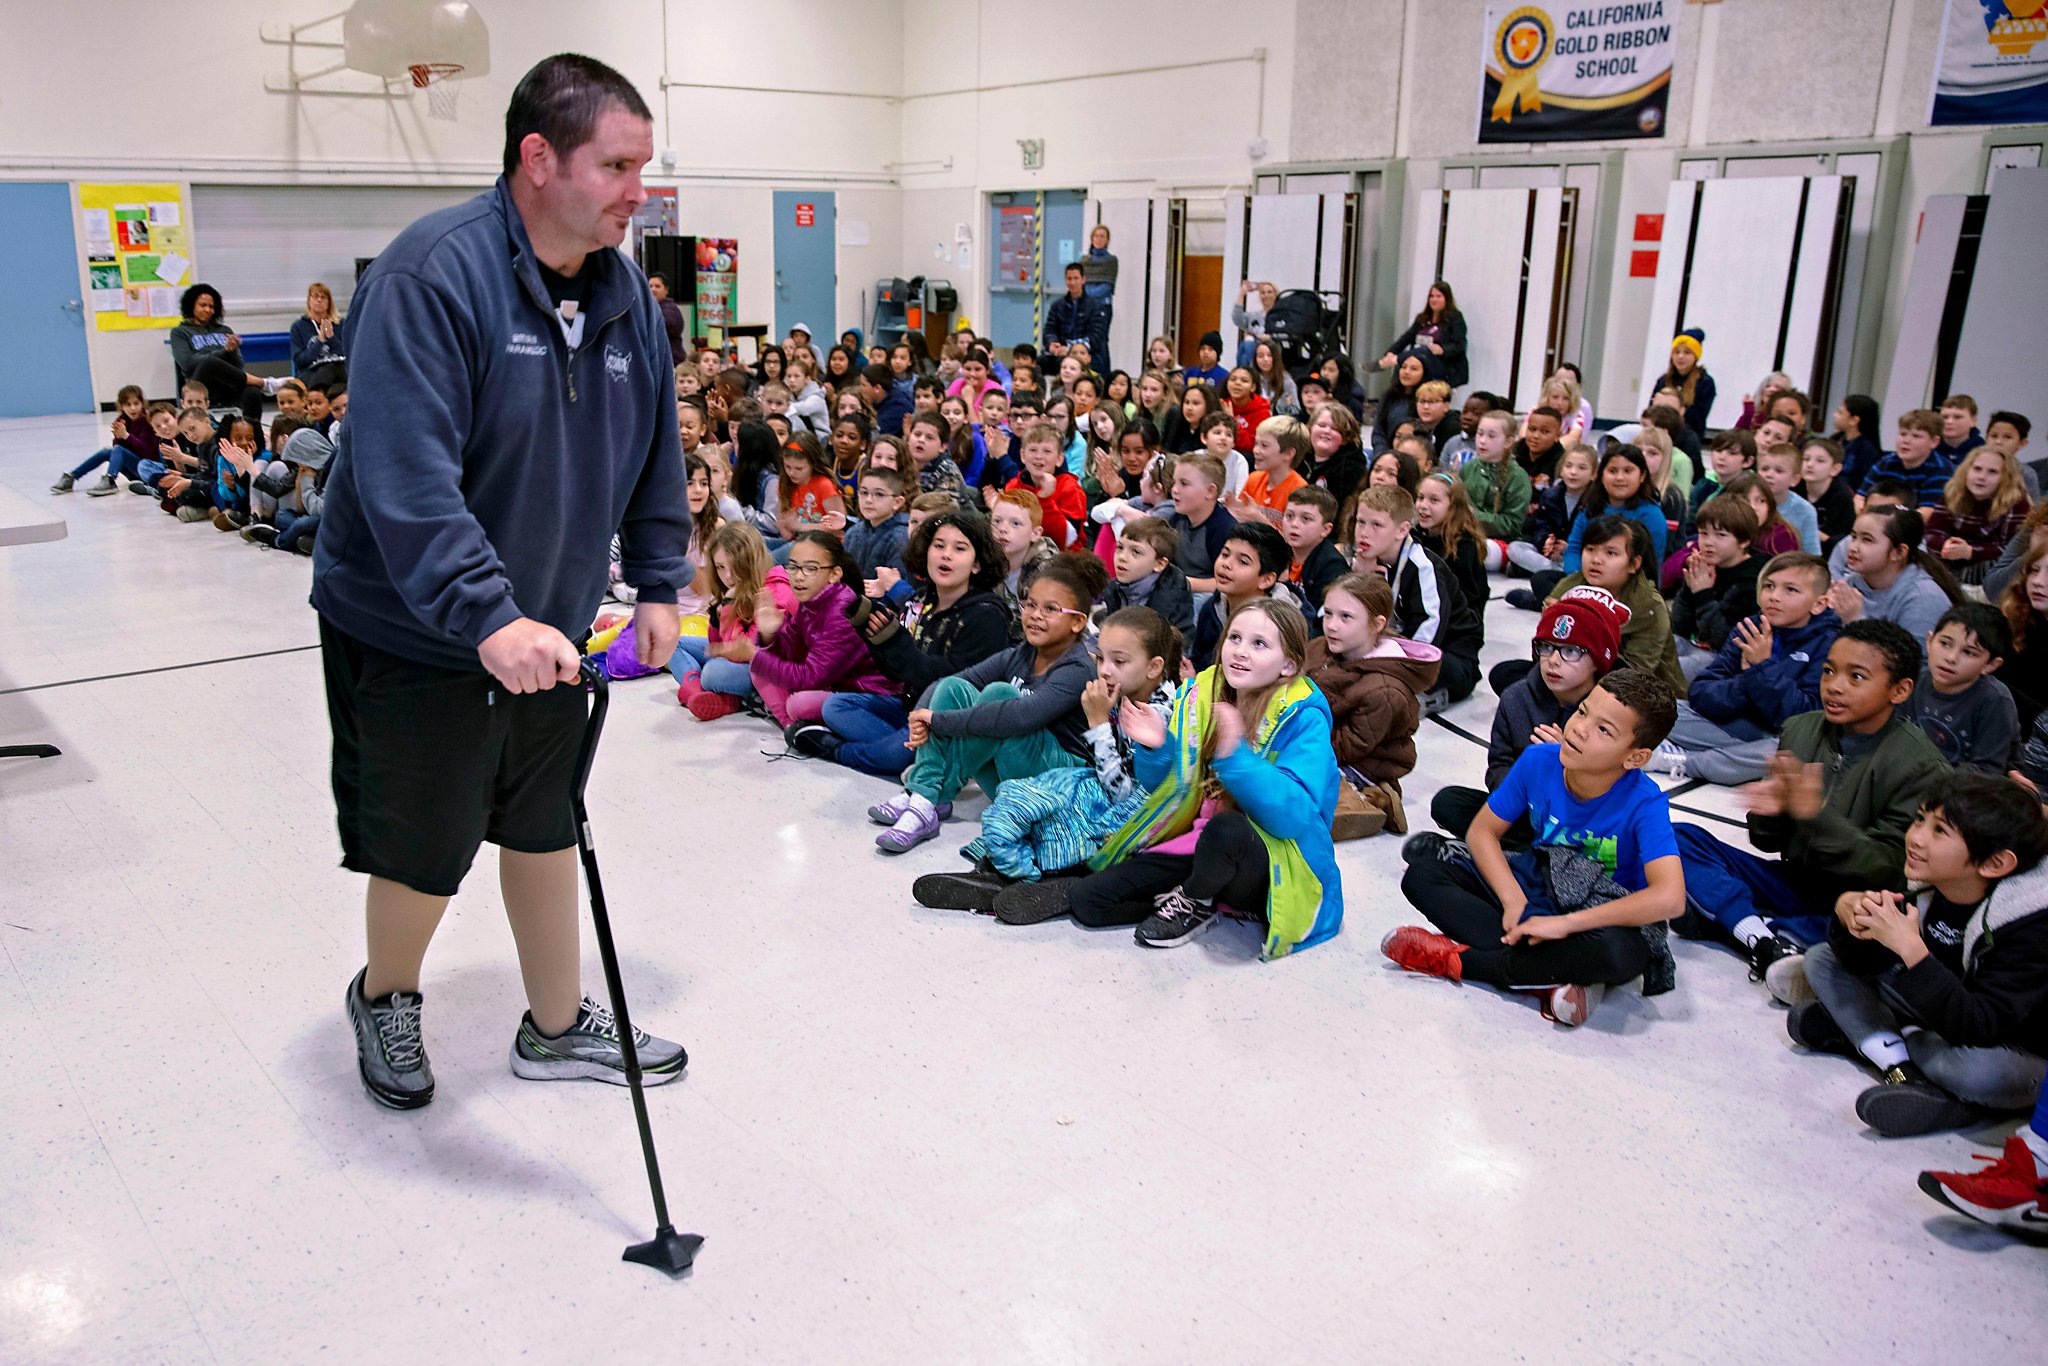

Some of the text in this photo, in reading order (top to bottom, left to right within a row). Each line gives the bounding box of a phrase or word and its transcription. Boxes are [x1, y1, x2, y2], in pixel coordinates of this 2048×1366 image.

[1566, 0, 1663, 29] CALIFORNIA
[1555, 25, 1671, 55] GOLD RIBBON
[1575, 56, 1639, 78] SCHOOL
